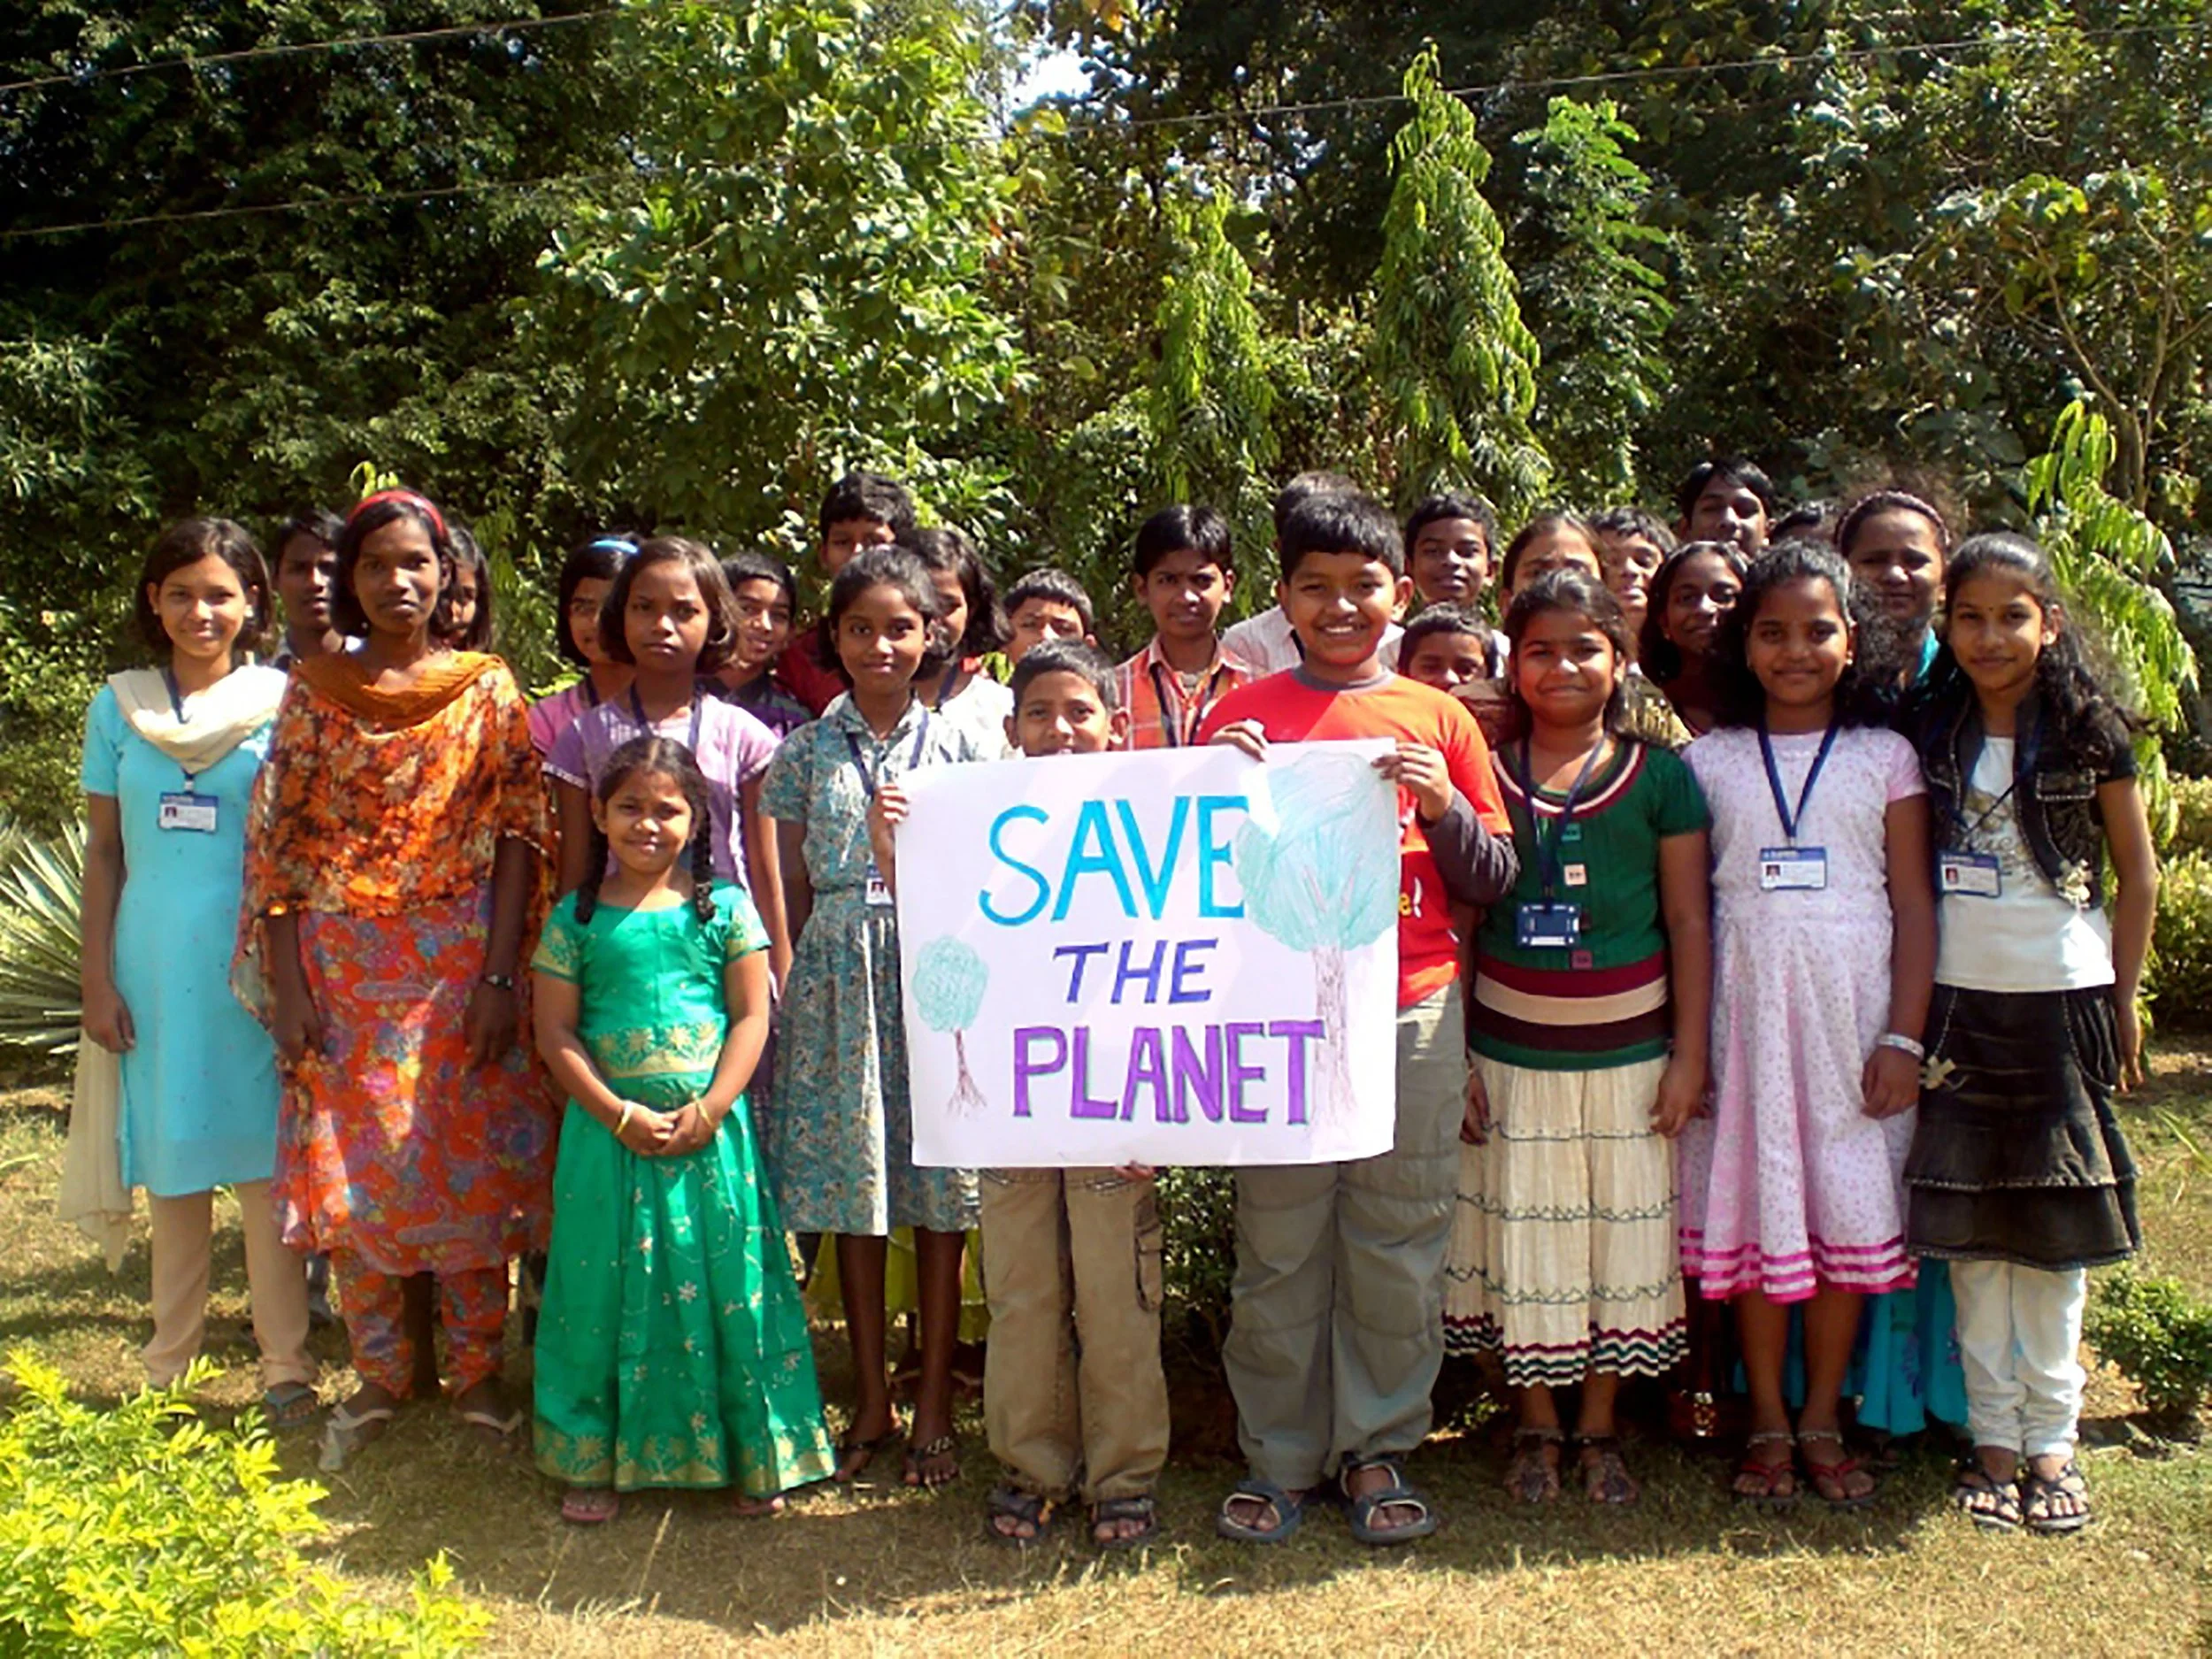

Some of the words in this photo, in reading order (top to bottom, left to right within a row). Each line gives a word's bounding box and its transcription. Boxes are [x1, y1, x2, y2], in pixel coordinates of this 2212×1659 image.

[979, 795, 1249, 926] SAVE
[1053, 939, 1218, 1004] THE
[1013, 1020, 1325, 1125] PLANET
